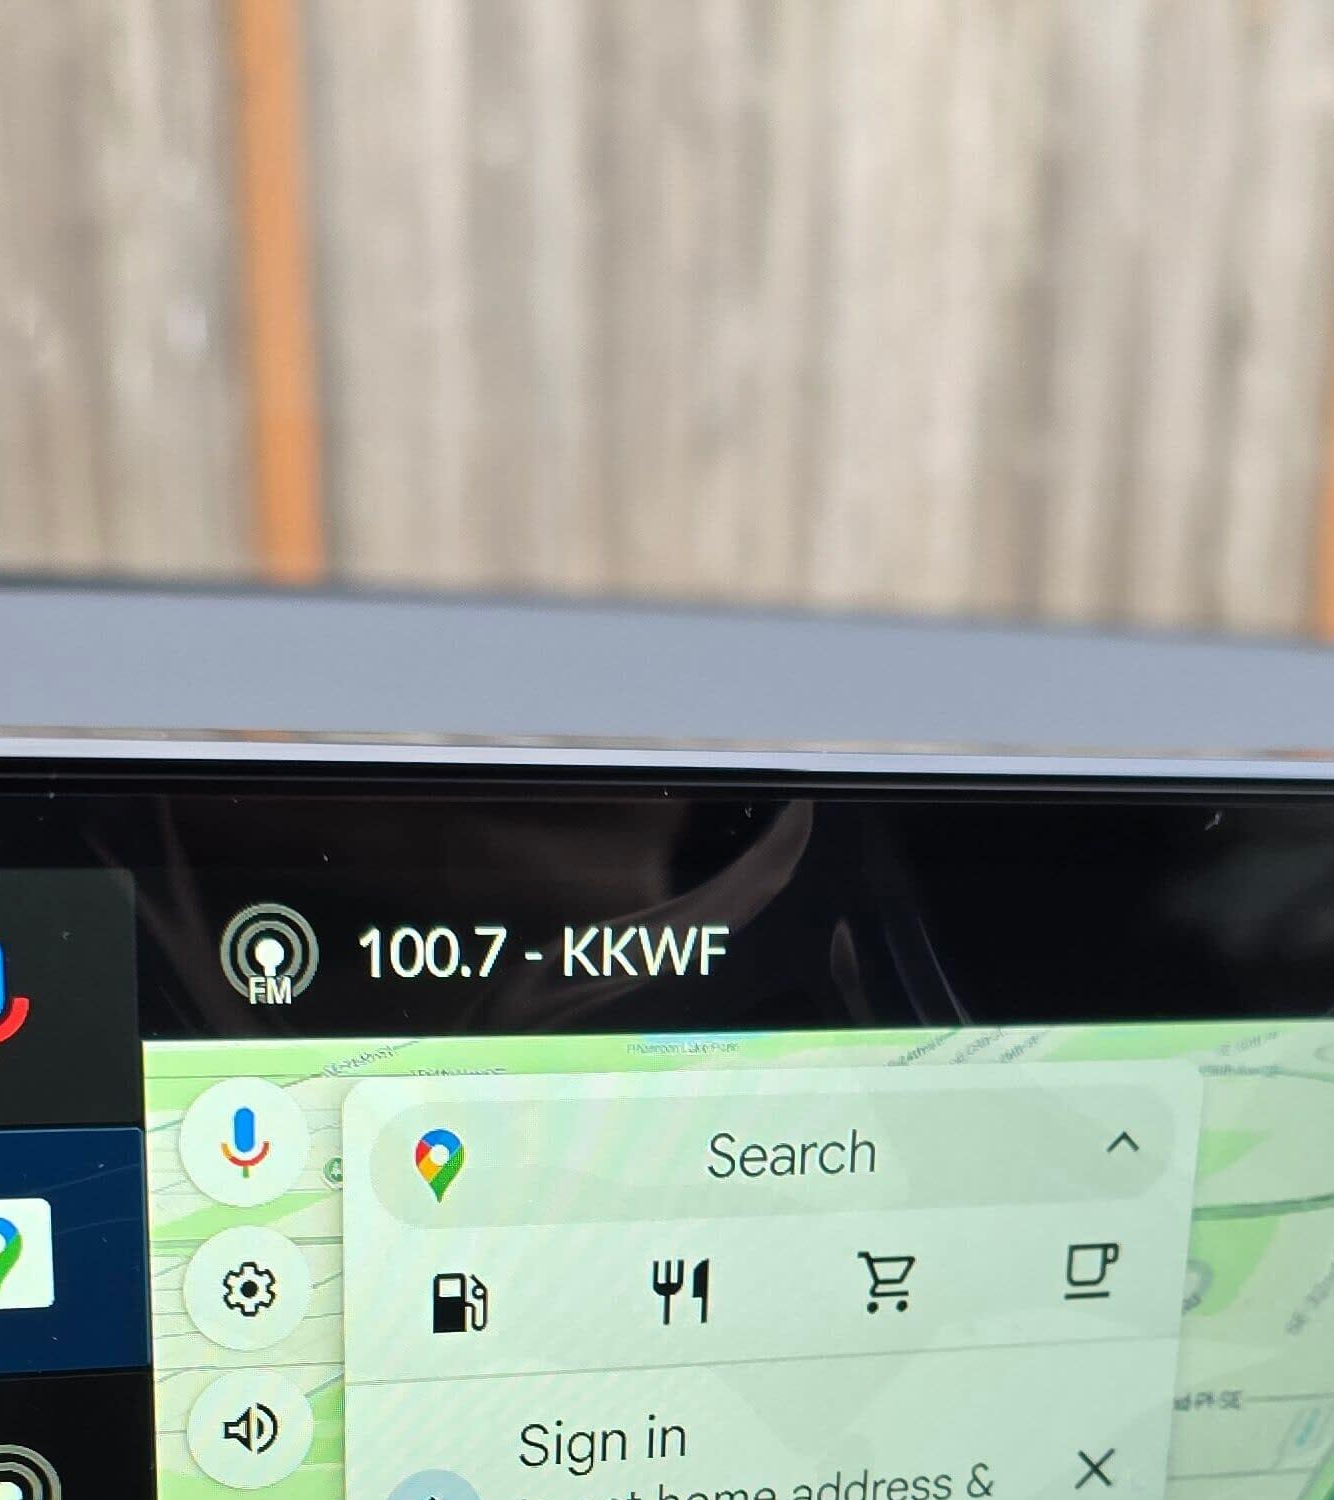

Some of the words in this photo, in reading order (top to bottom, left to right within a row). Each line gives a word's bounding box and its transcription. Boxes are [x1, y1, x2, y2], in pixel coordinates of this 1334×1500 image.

[358, 926, 508, 980] 100.7
[562, 925, 730, 978] KKWF
[248, 975, 292, 1006] FM
[707, 1129, 877, 1179] Search
[518, 1420, 627, 1476] Sign
[646, 1414, 686, 1459] in
[966, 1462, 996, 1499] &
